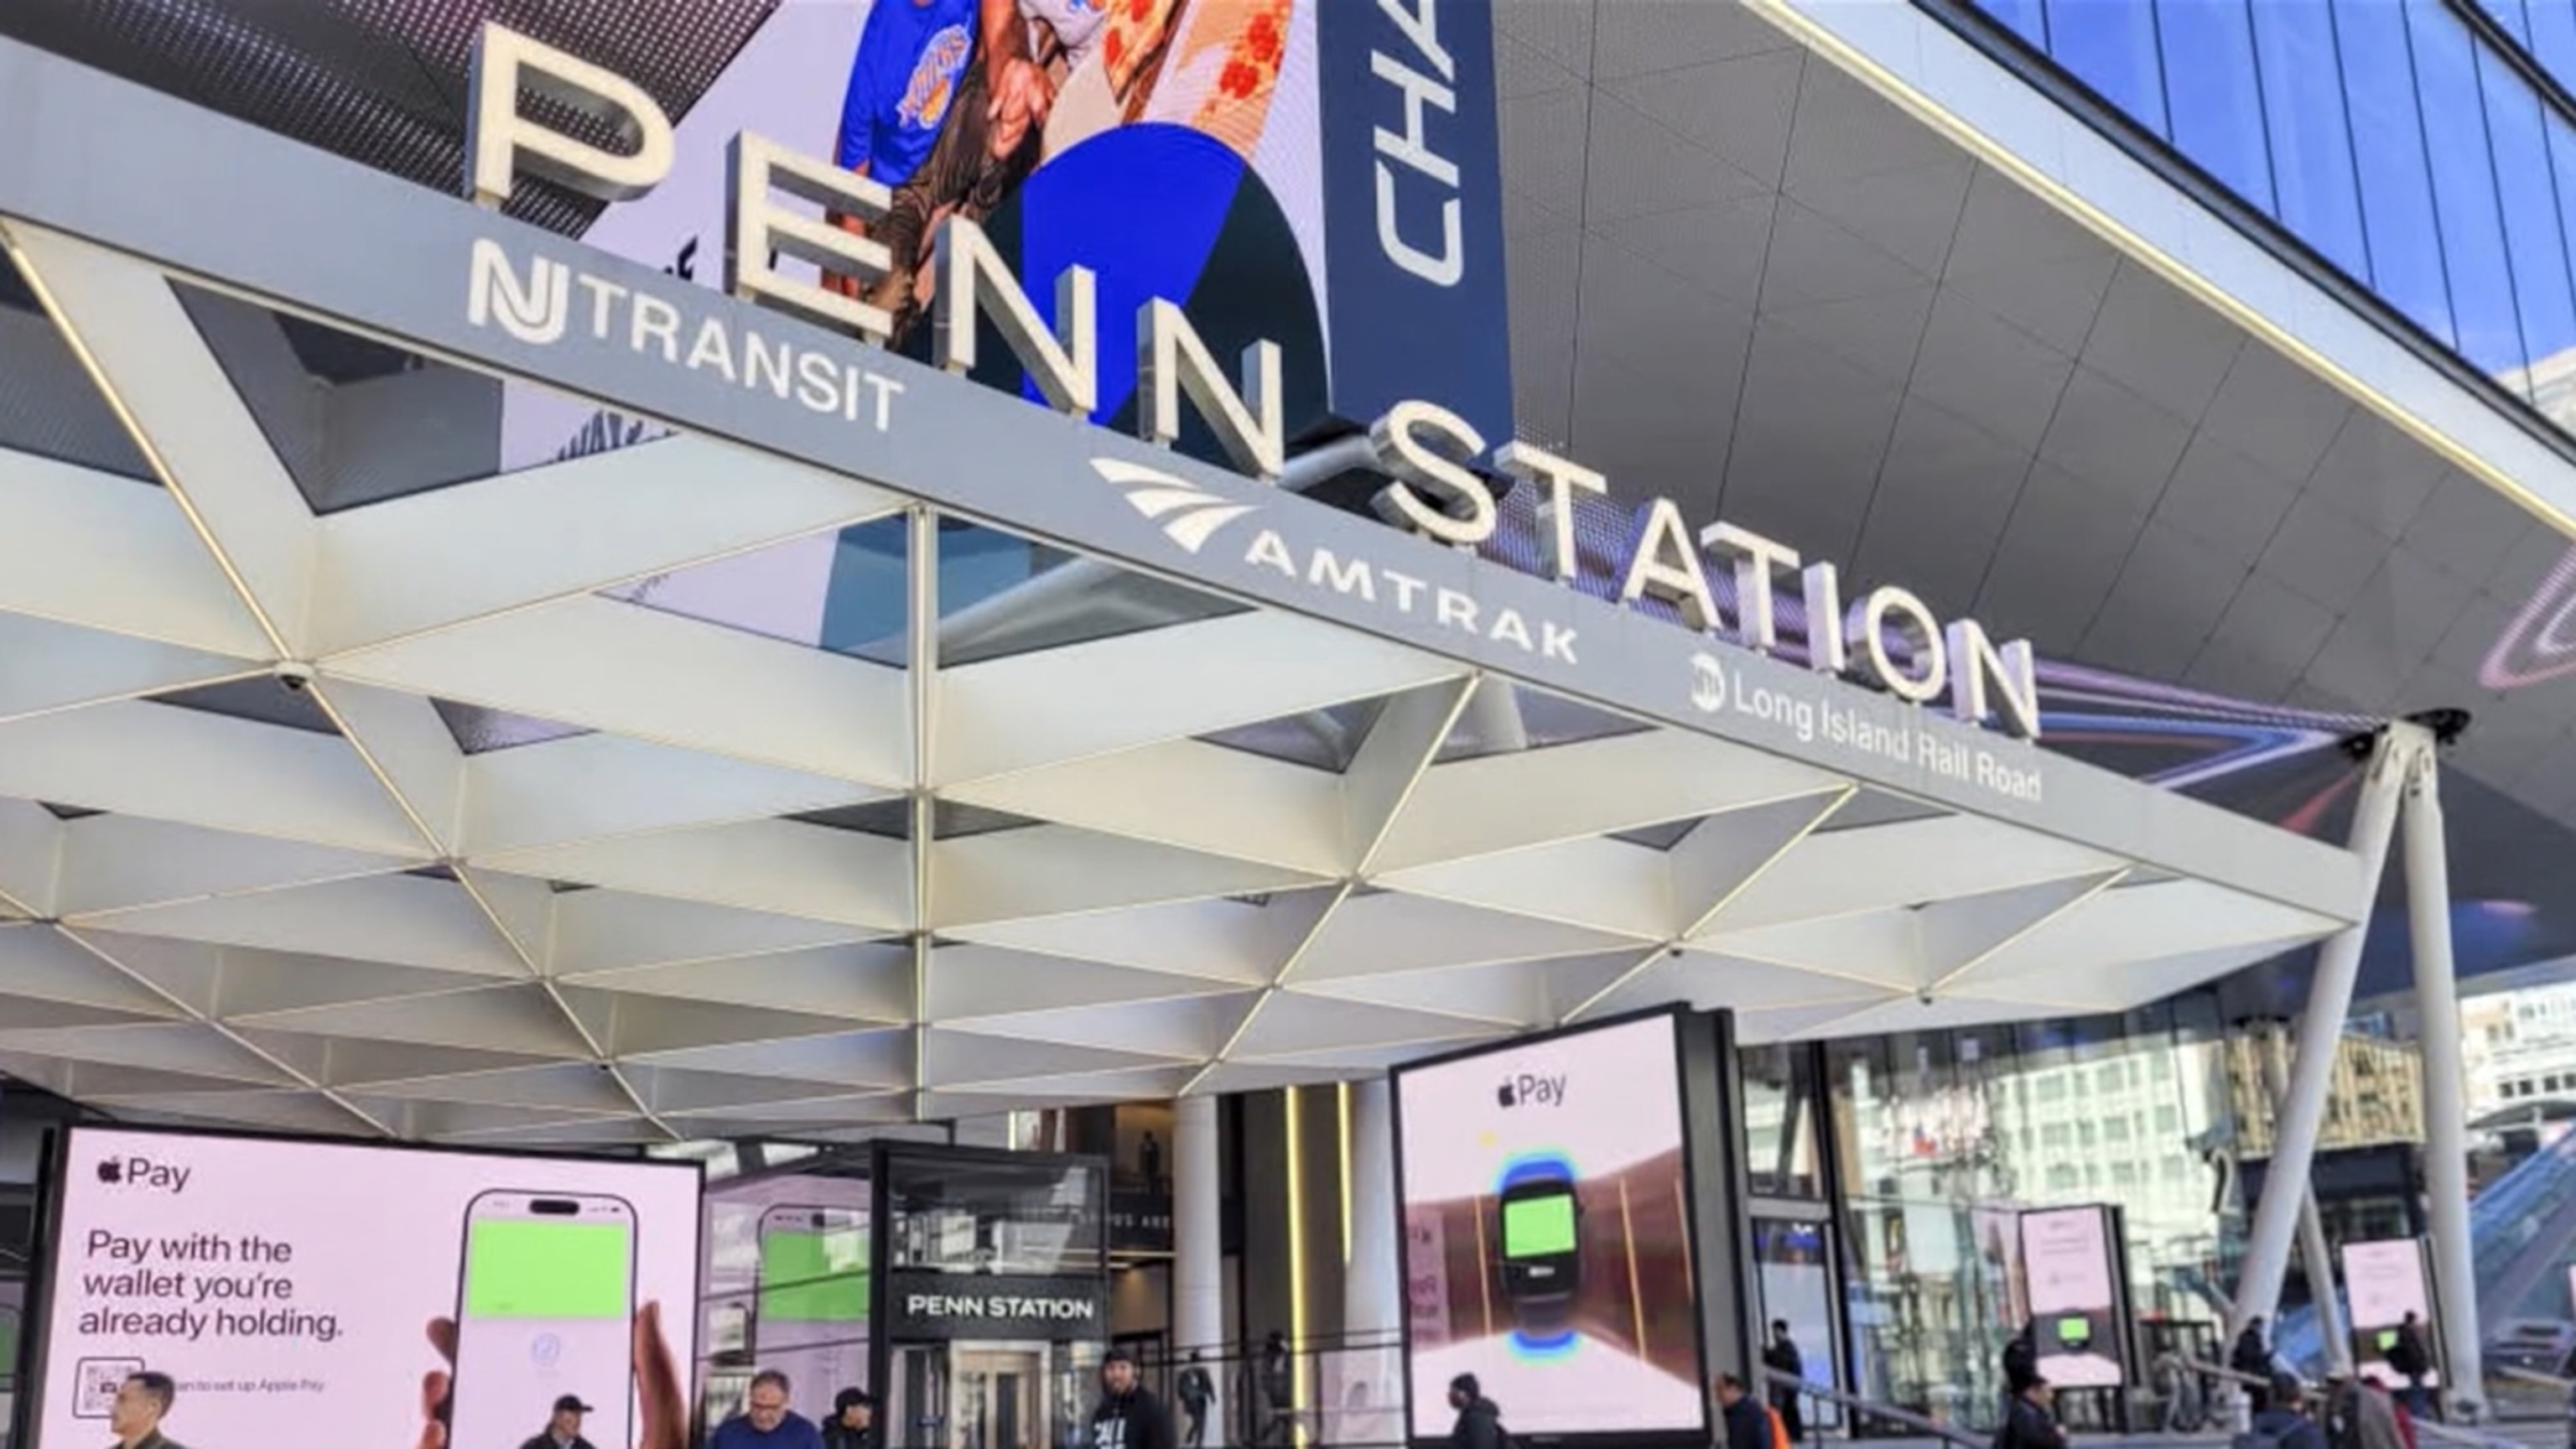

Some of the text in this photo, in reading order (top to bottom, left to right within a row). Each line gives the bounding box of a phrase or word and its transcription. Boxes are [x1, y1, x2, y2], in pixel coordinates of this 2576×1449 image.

[578, 272, 906, 433] TRANSIT
[466, 22, 2041, 738] PENN STATION
[1244, 528, 1580, 666] AMTRAK
[1733, 672, 1814, 742] Long
[1822, 706, 1911, 762] Island
[1918, 733, 1971, 782] Rail
[1977, 751, 2042, 802] Road
[1519, 1073, 1566, 1107] Pay
[127, 1156, 192, 1194] Pay
[87, 1228, 293, 1265] Pay with the
[82, 1268, 294, 1304] wallet you're
[78, 1306, 344, 1343] already holding.
[907, 1295, 1094, 1320] PENN STATION
